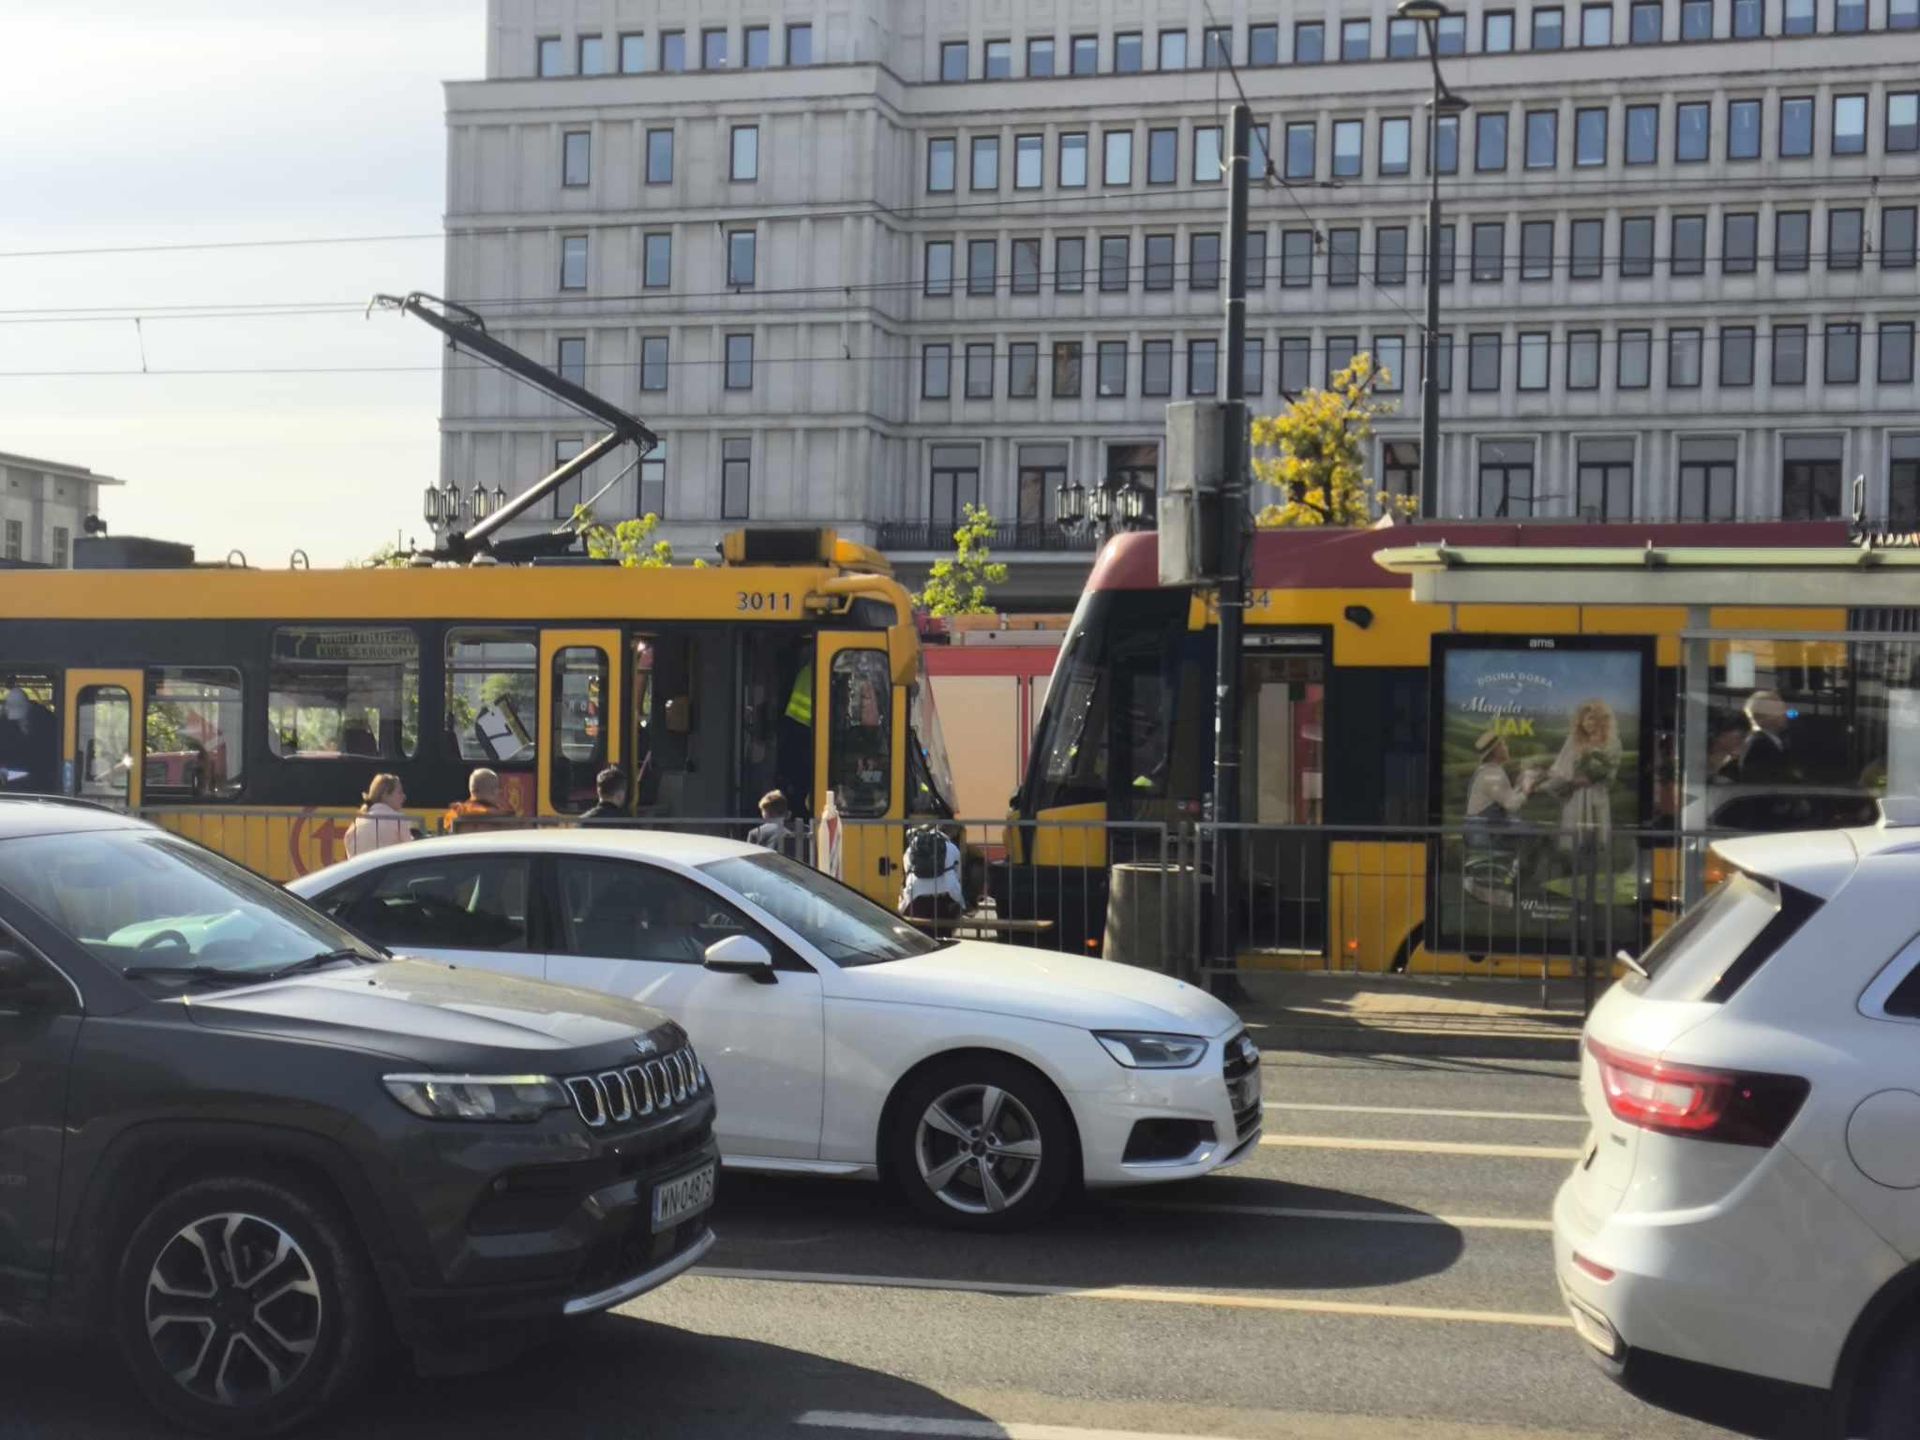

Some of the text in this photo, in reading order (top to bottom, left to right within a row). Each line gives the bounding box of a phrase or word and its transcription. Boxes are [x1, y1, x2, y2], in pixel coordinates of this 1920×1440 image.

[736, 591, 790, 610] 3011
[1529, 638, 1555, 648] ams
[1477, 672, 1515, 688] DOLINA
[1461, 696, 1522, 718] Magda
